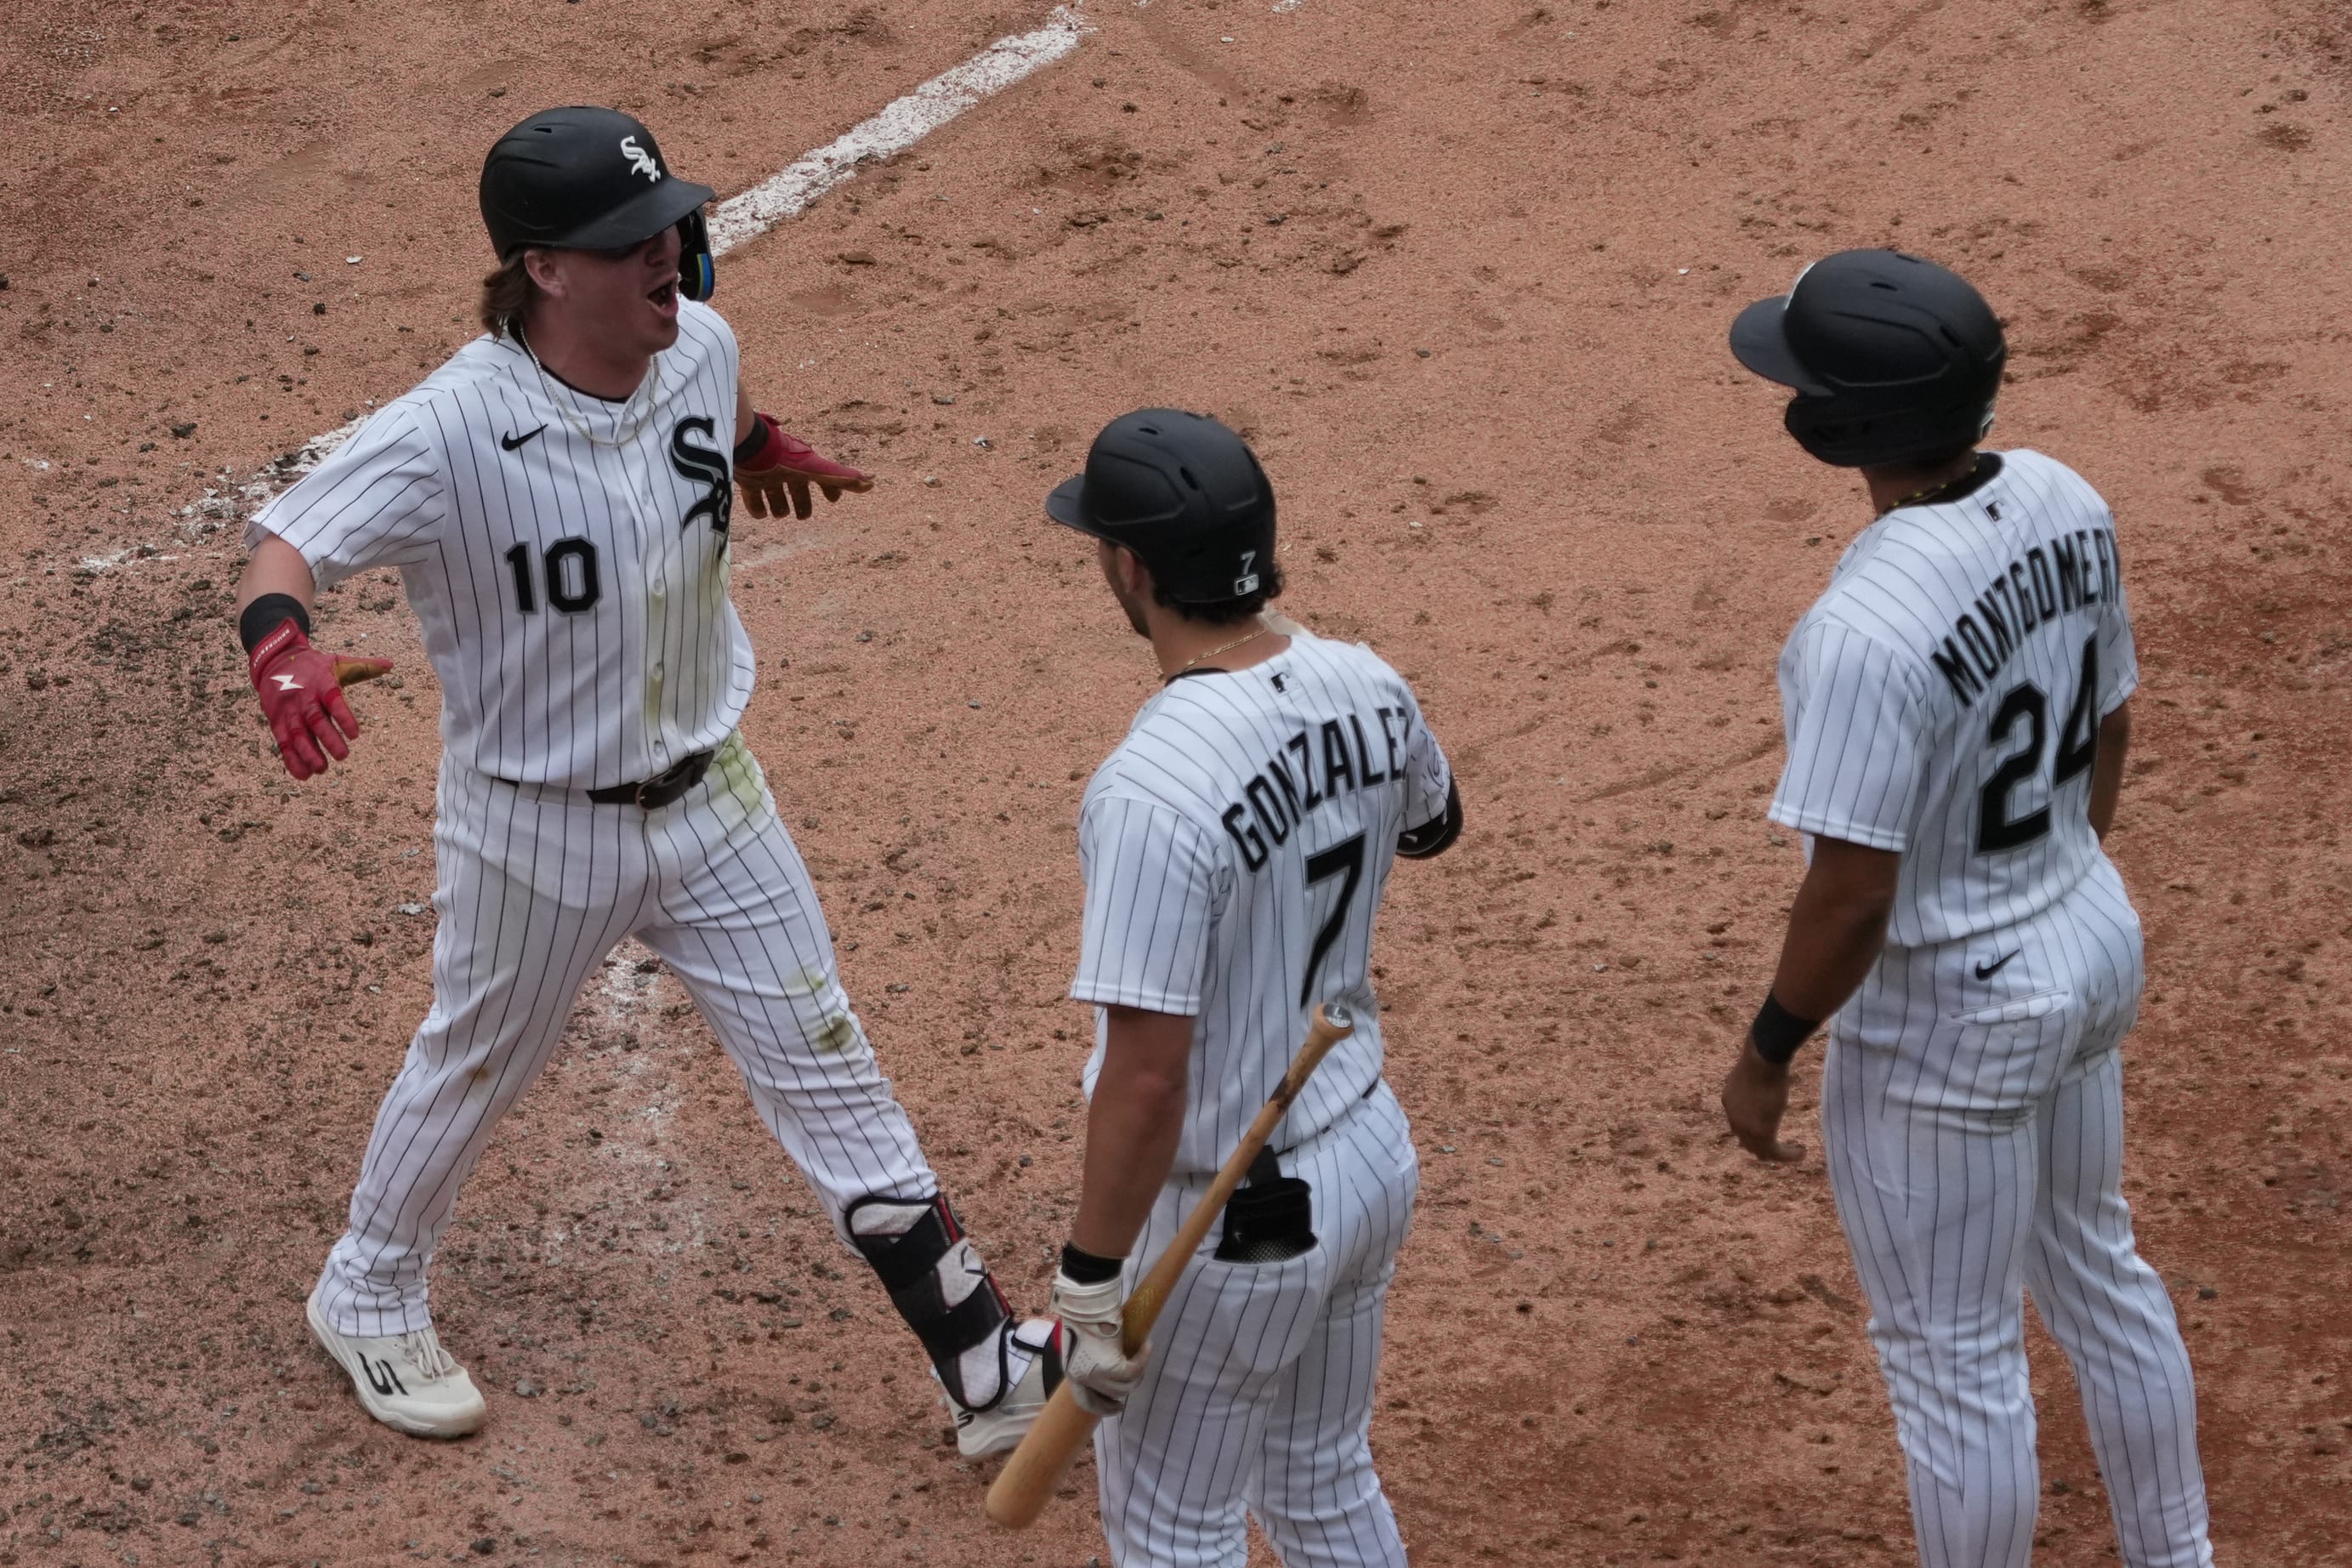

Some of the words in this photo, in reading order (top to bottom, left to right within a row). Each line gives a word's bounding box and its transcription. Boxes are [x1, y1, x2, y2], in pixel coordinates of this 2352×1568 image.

[503, 535, 604, 616] 10
[1240, 550, 1256, 575] 7
[1973, 626, 2099, 857] 24
[1300, 830, 1366, 1010] 7
